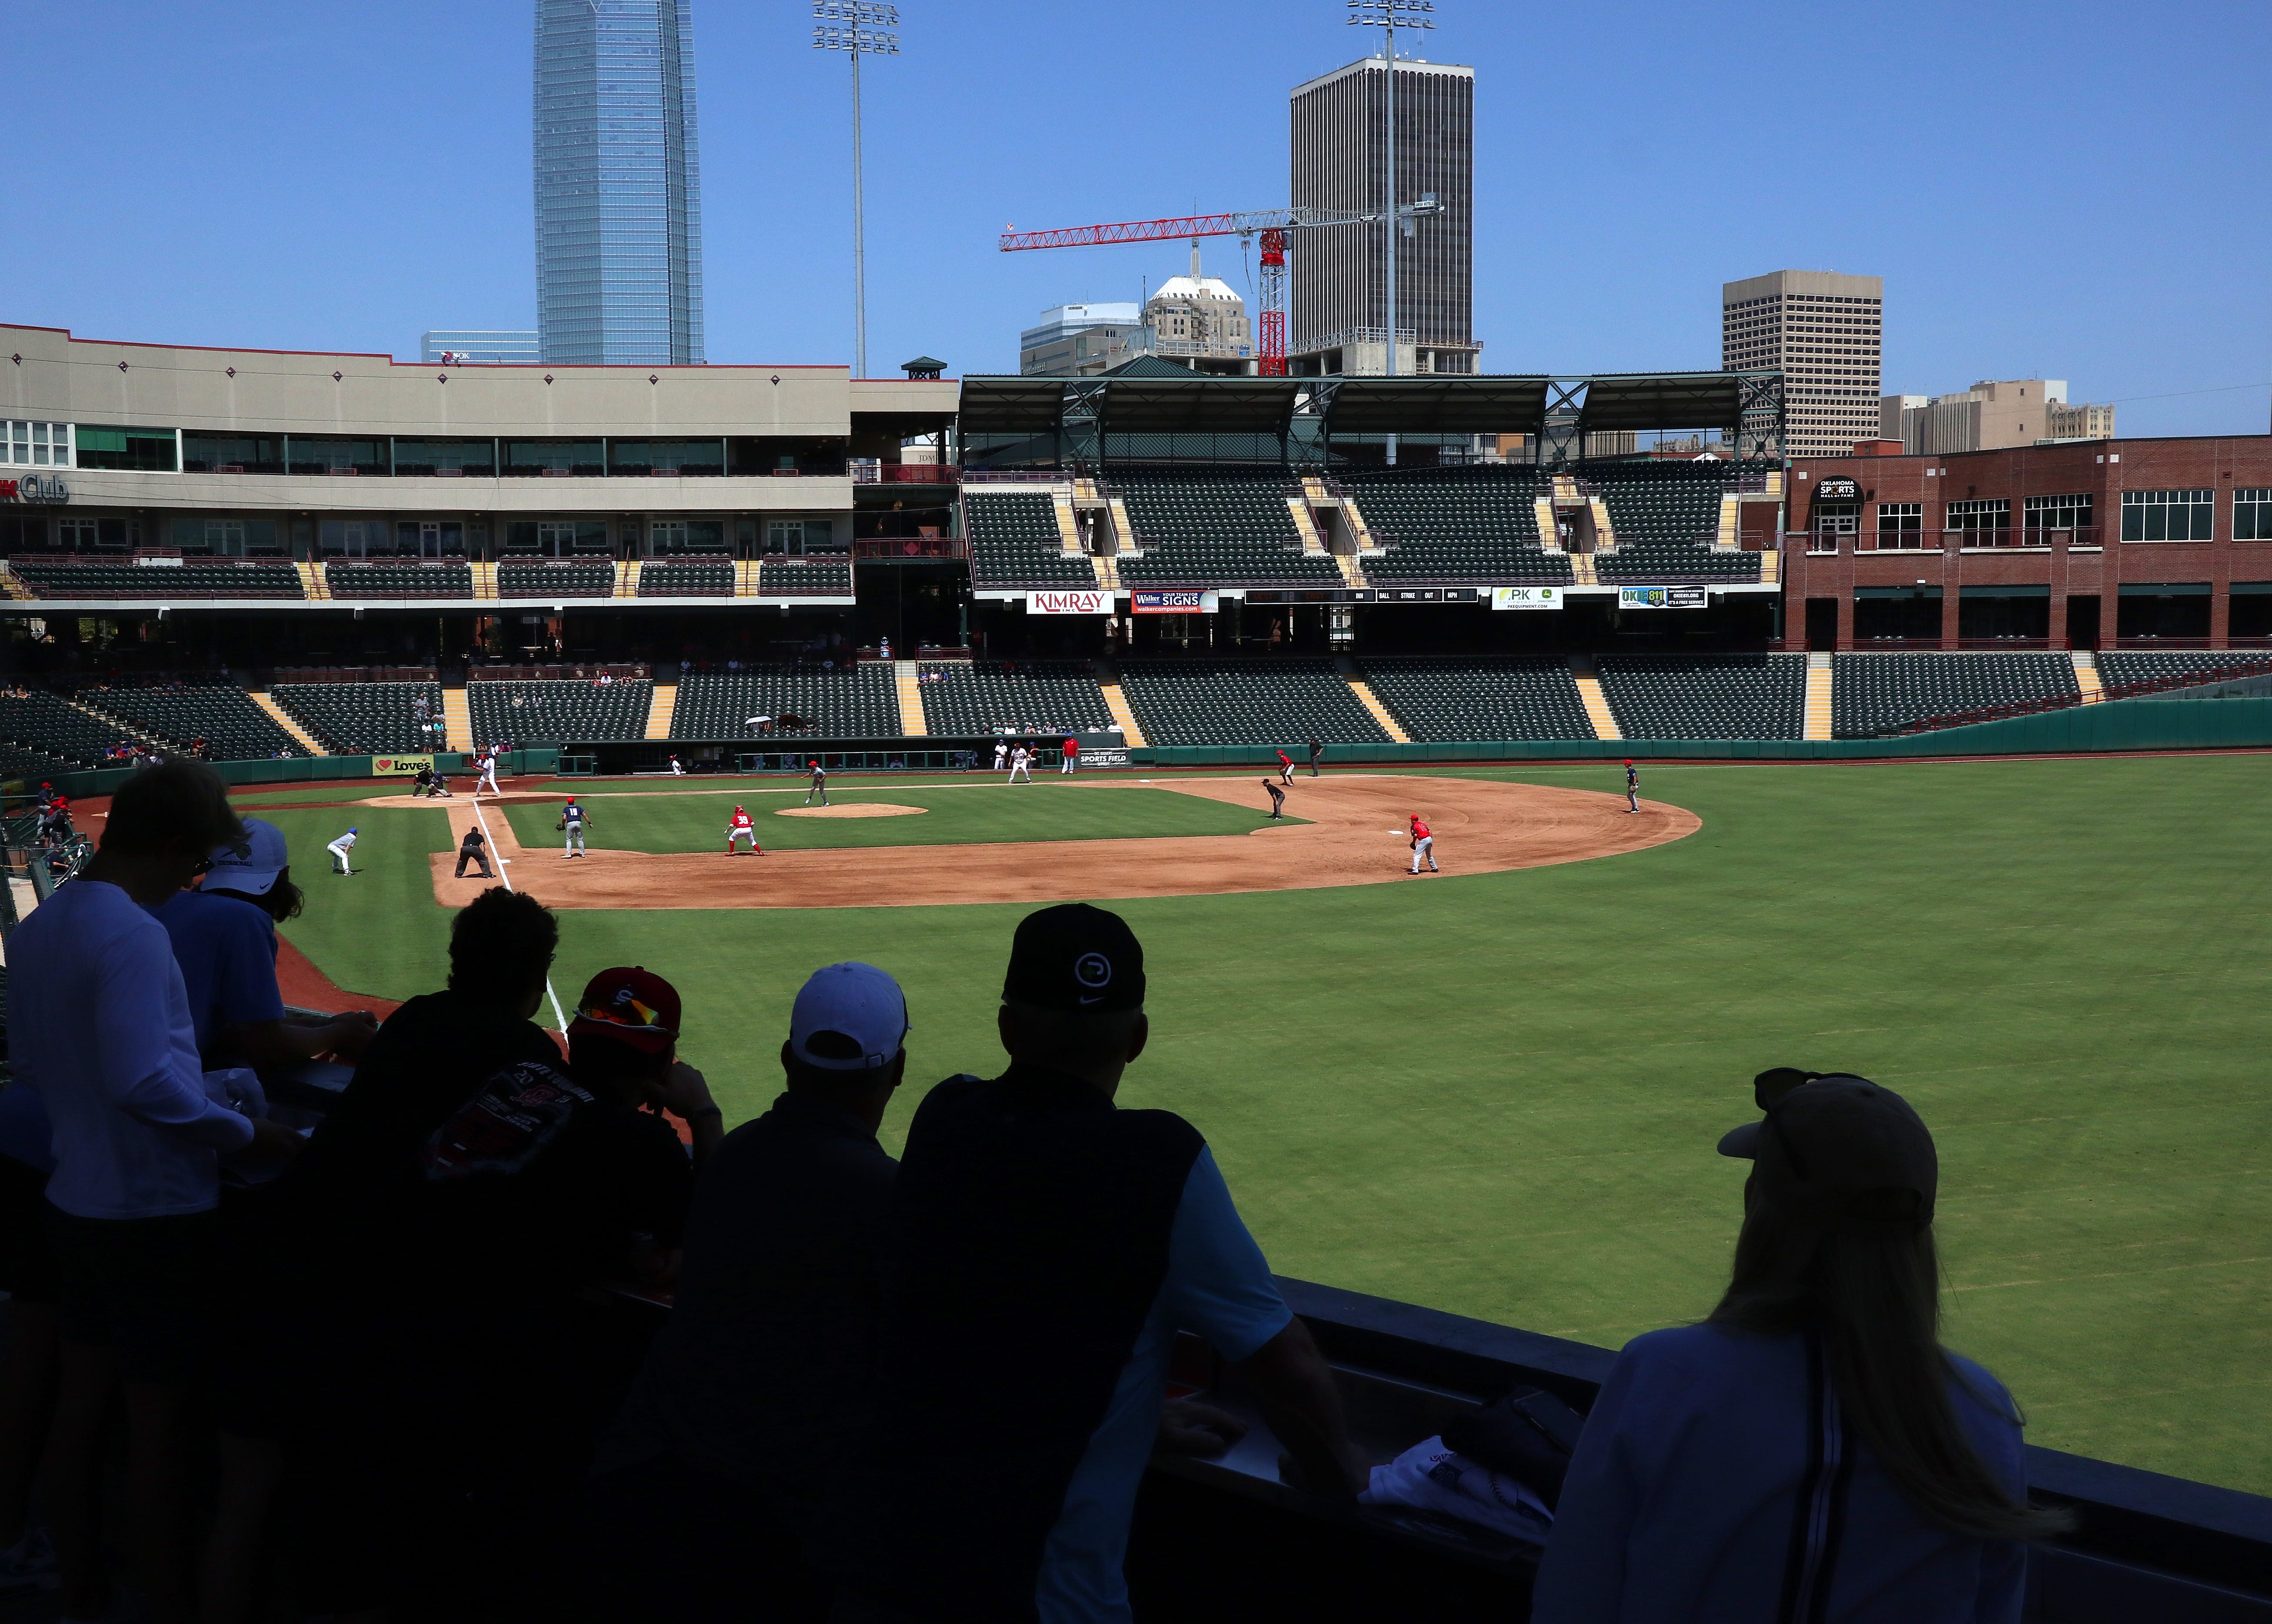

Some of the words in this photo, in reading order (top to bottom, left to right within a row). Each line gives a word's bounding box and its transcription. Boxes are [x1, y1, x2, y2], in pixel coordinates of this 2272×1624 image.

[0, 480, 19, 498] K
[21, 474, 68, 499] Club
[1036, 594, 1105, 612] KIMRAY
[1136, 595, 1160, 604] Walker
[1162, 596, 1198, 605] SIGNS
[737, 815, 748, 824] 39
